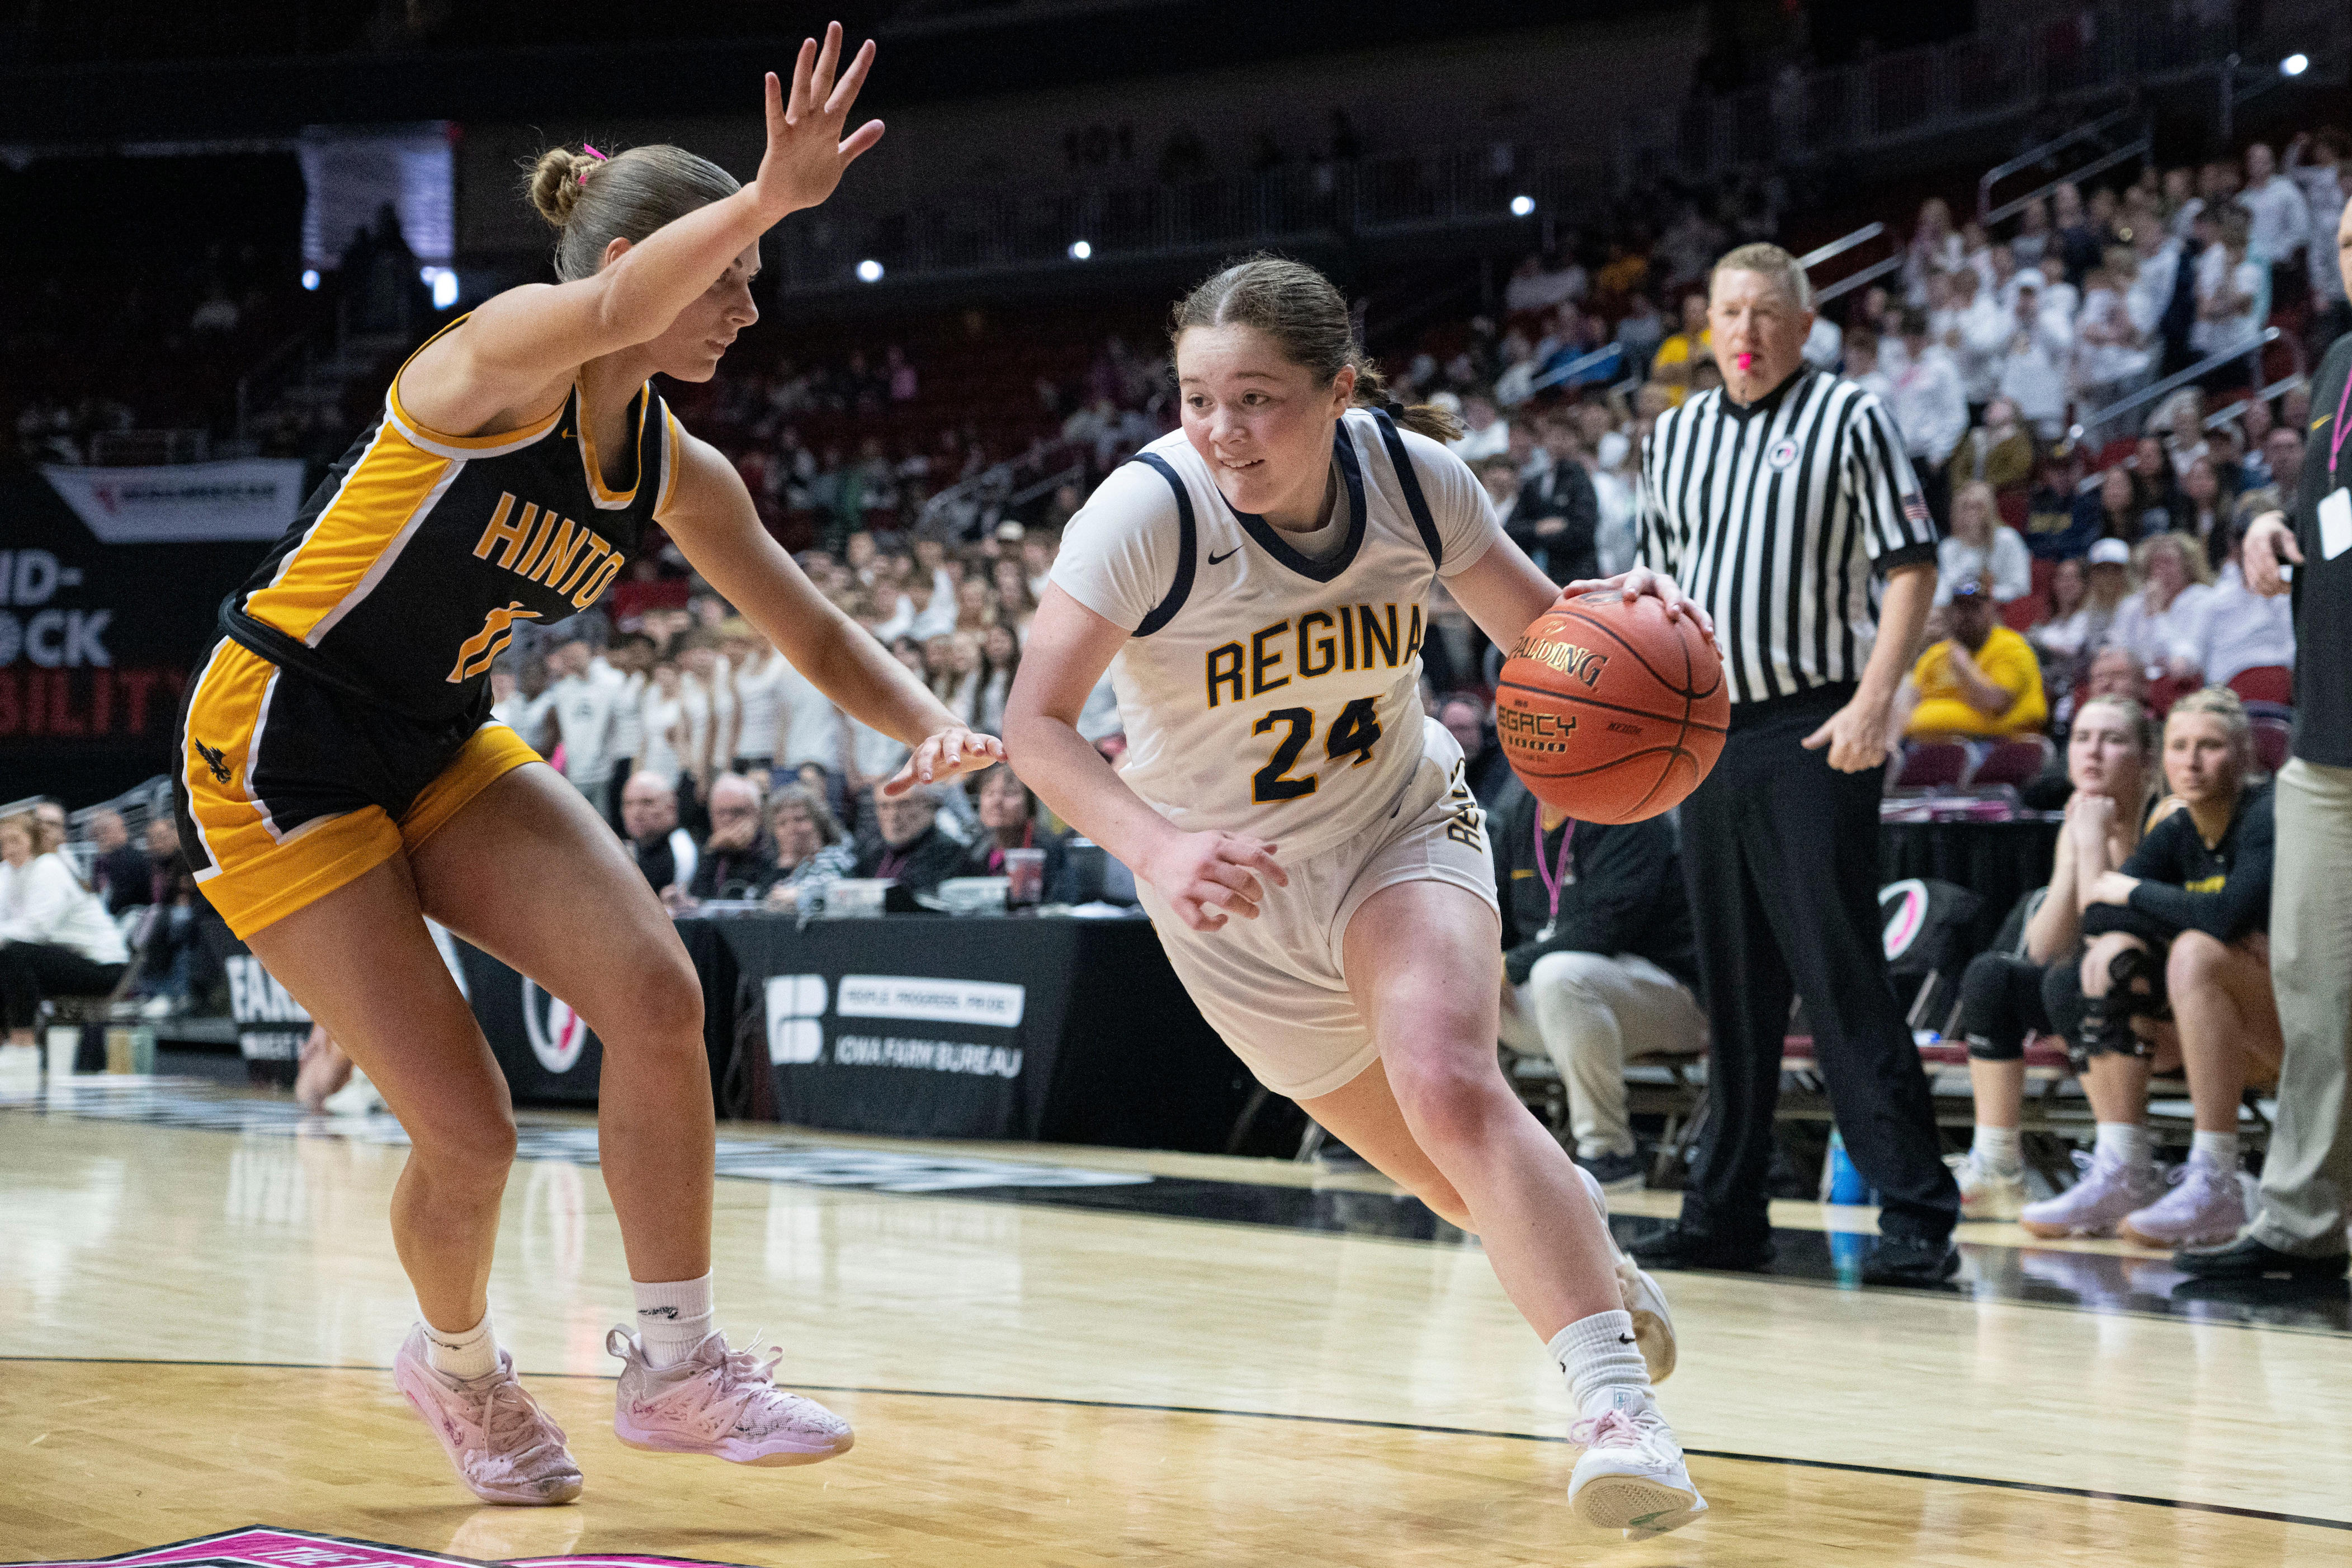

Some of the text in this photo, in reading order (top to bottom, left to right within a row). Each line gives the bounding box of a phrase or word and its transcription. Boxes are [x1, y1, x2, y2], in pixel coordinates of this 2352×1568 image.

[1205, 602, 1422, 710] REGINA
[1251, 693, 1386, 805] 24
[935, 1041, 1024, 1079] BUREAU
[250, 1546, 371, 1566] THE
